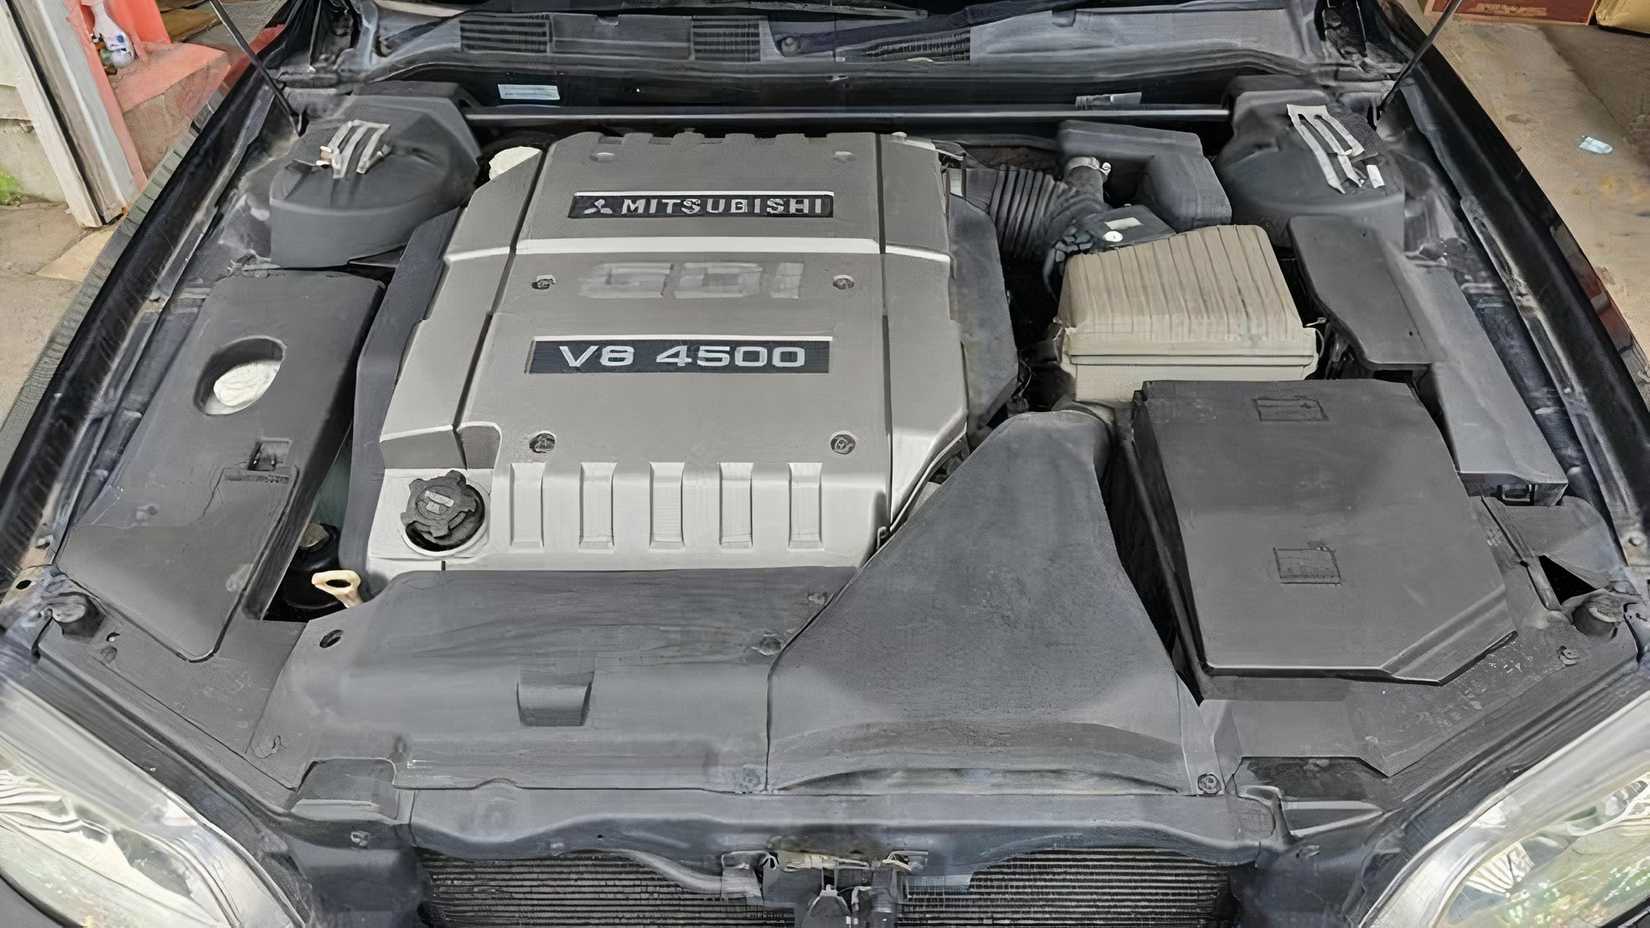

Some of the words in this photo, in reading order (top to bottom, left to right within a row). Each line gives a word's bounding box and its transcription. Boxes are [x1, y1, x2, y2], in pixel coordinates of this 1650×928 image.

[621, 198, 823, 215] MITSUBISHI
[559, 345, 635, 368] V8
[655, 345, 806, 368] 4500
